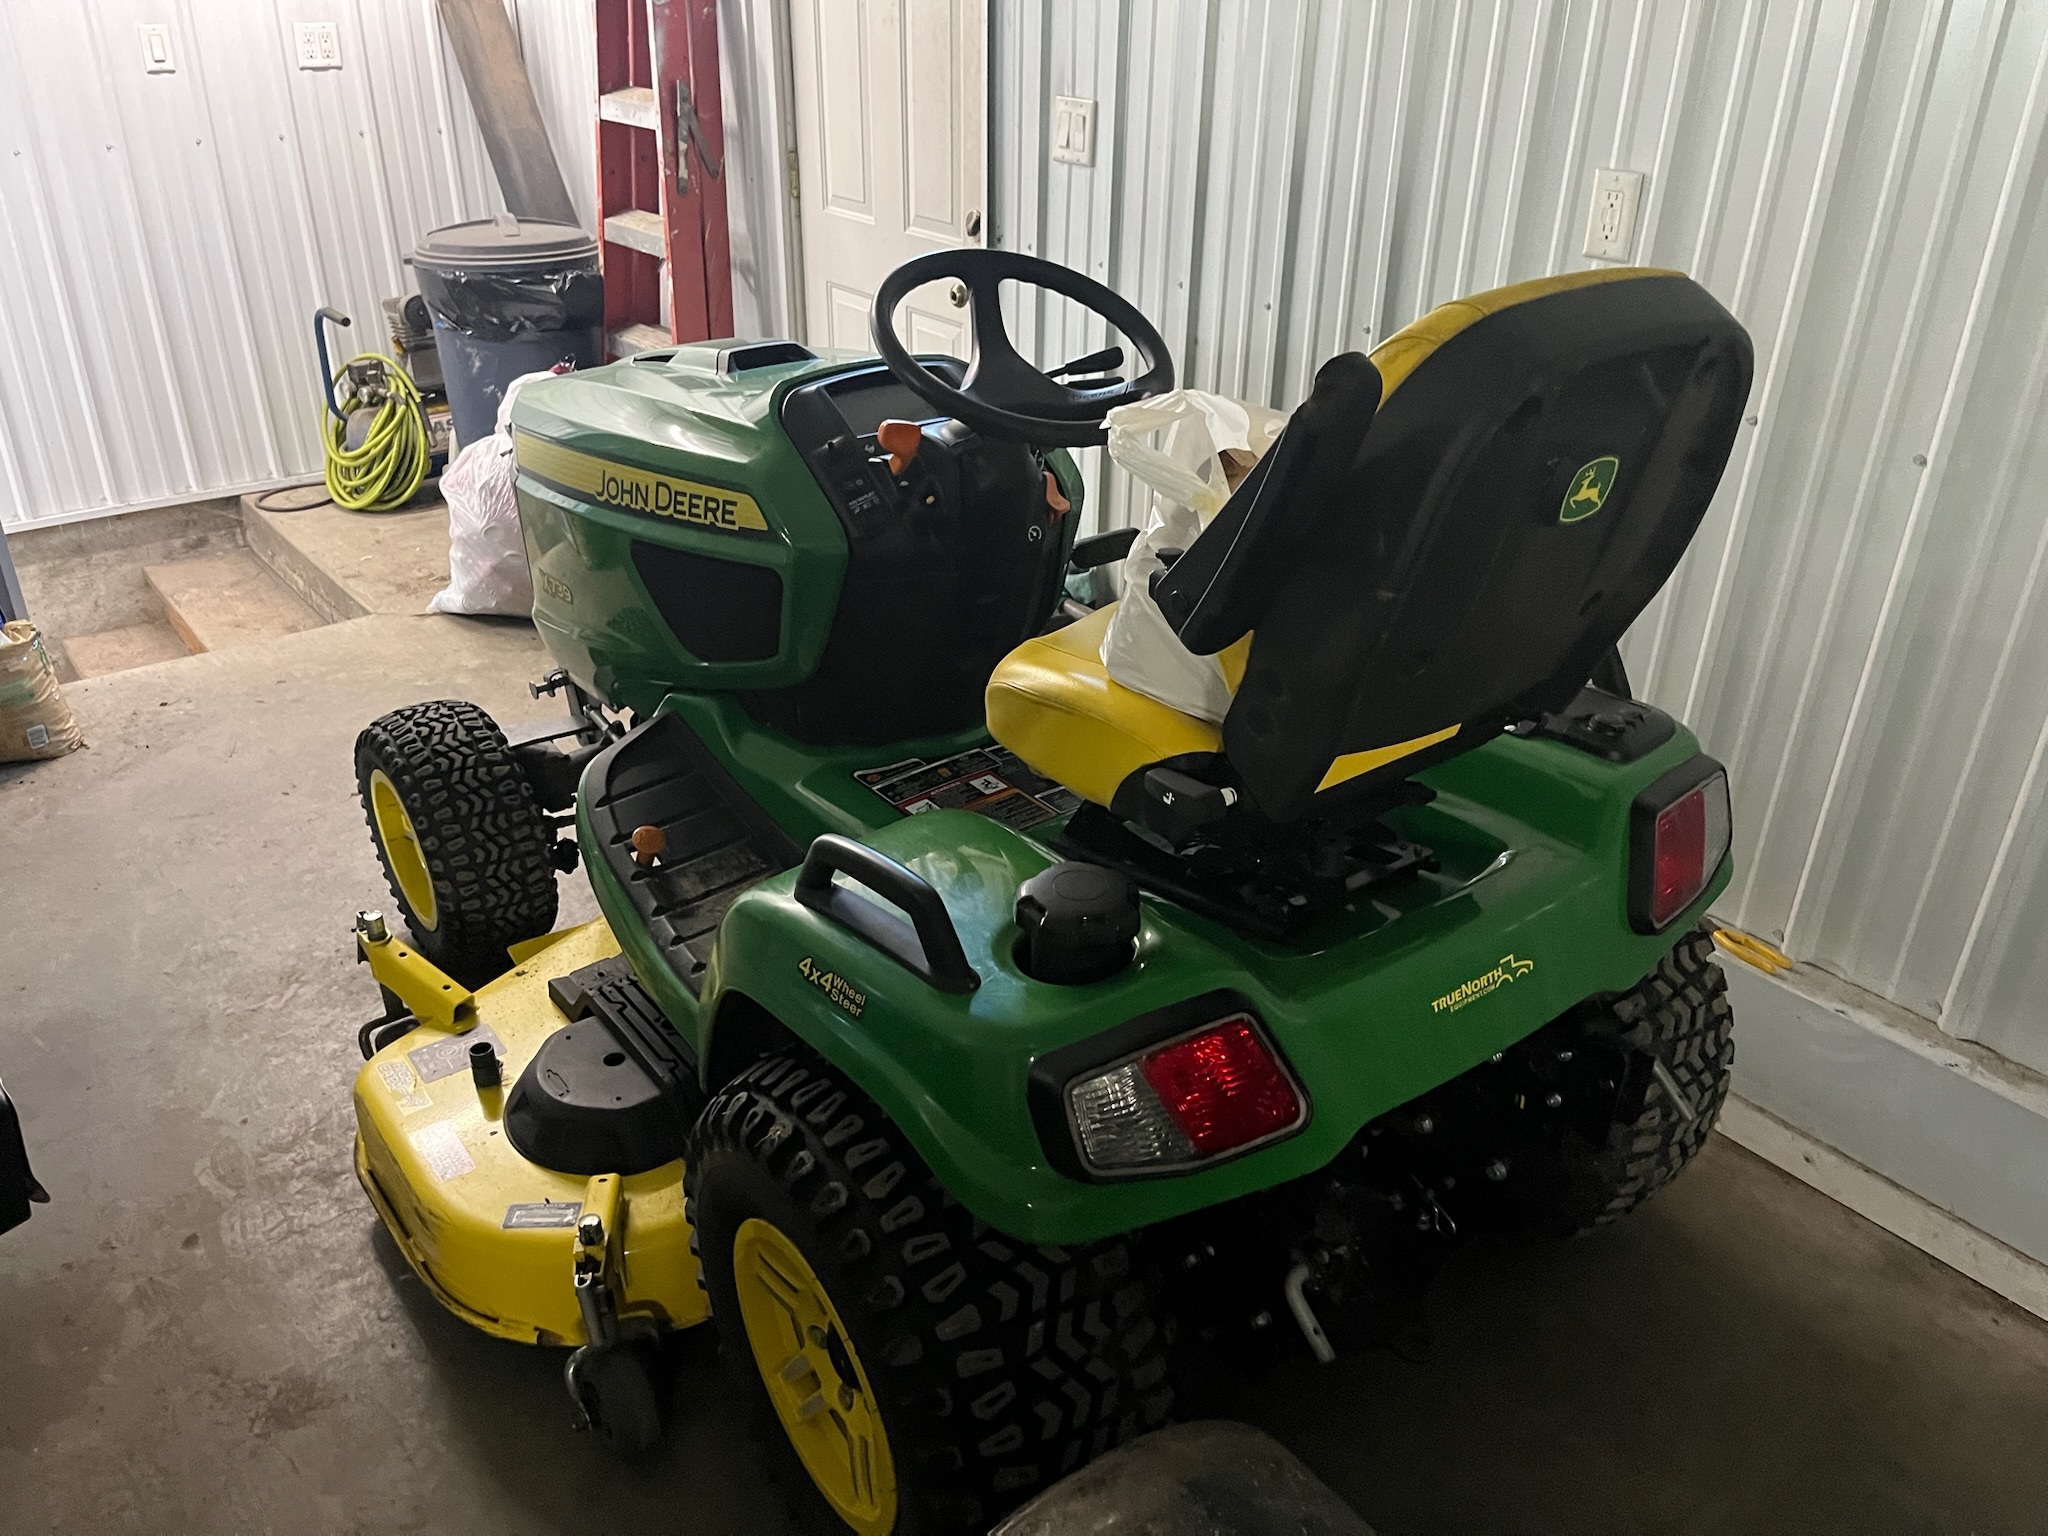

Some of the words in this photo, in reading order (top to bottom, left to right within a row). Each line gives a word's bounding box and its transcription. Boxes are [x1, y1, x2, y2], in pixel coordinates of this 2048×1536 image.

[595, 469, 649, 508] JOHN
[655, 481, 738, 526] DEERE
[539, 568, 573, 603] X739
[798, 957, 833, 992] 4x4
[833, 974, 866, 1006] Wheel
[830, 988, 862, 1016] Steer
